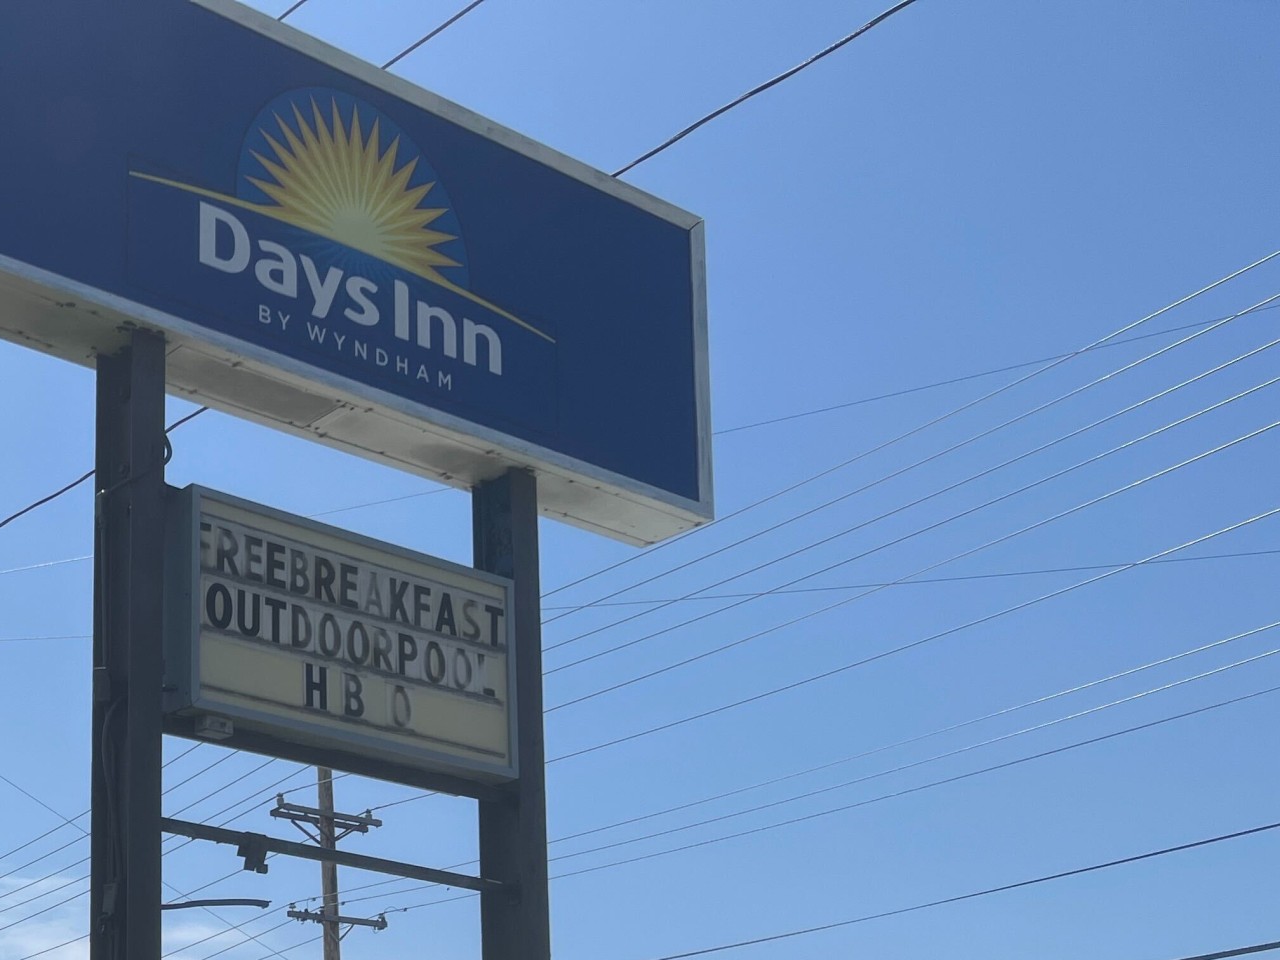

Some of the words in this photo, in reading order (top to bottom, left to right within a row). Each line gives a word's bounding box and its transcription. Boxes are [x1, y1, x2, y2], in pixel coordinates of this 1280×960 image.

[198, 200, 380, 327] Days
[394, 279, 502, 375] Inn
[259, 304, 289, 330] BY
[307, 322, 453, 391] WYNDHAM
